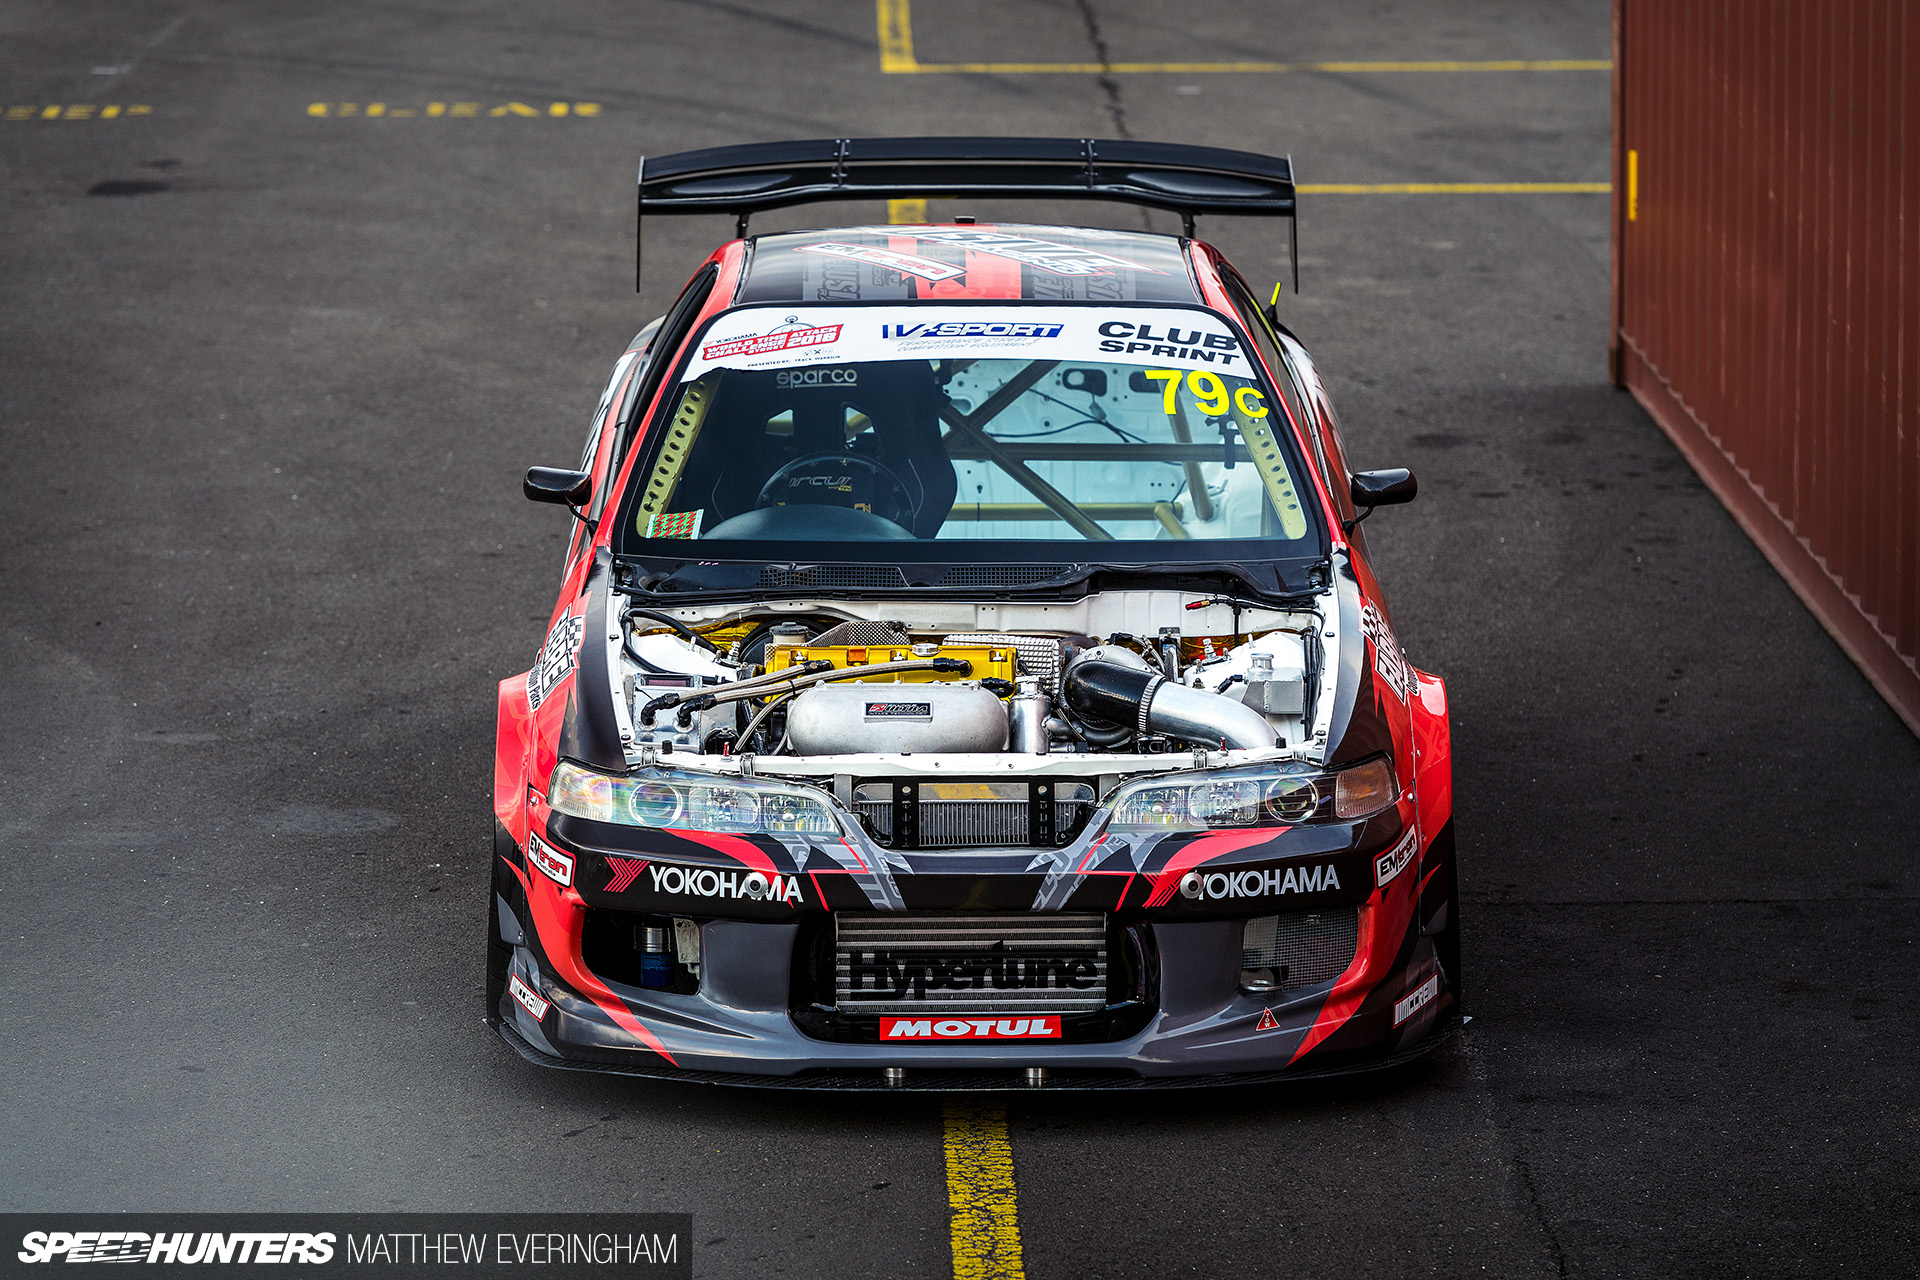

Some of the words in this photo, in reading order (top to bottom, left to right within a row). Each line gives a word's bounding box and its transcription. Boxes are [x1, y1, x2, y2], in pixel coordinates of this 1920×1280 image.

[307, 101, 601, 118] CLEAR
[707, 339, 754, 354] WORLD
[755, 334, 788, 346] TIME
[790, 326, 838, 338] ATTACK
[716, 333, 758, 344] YOKOHAMA
[1098, 321, 1239, 350] CLUB
[706, 341, 786, 359] CHALLENGE
[1098, 340, 1240, 365] SPRINT
[747, 359, 780, 367] PRESENTED
[776, 369, 857, 389] sparco
[850, 939, 1099, 1000] Hypertune
[888, 1019, 1053, 1037] MOTUL
